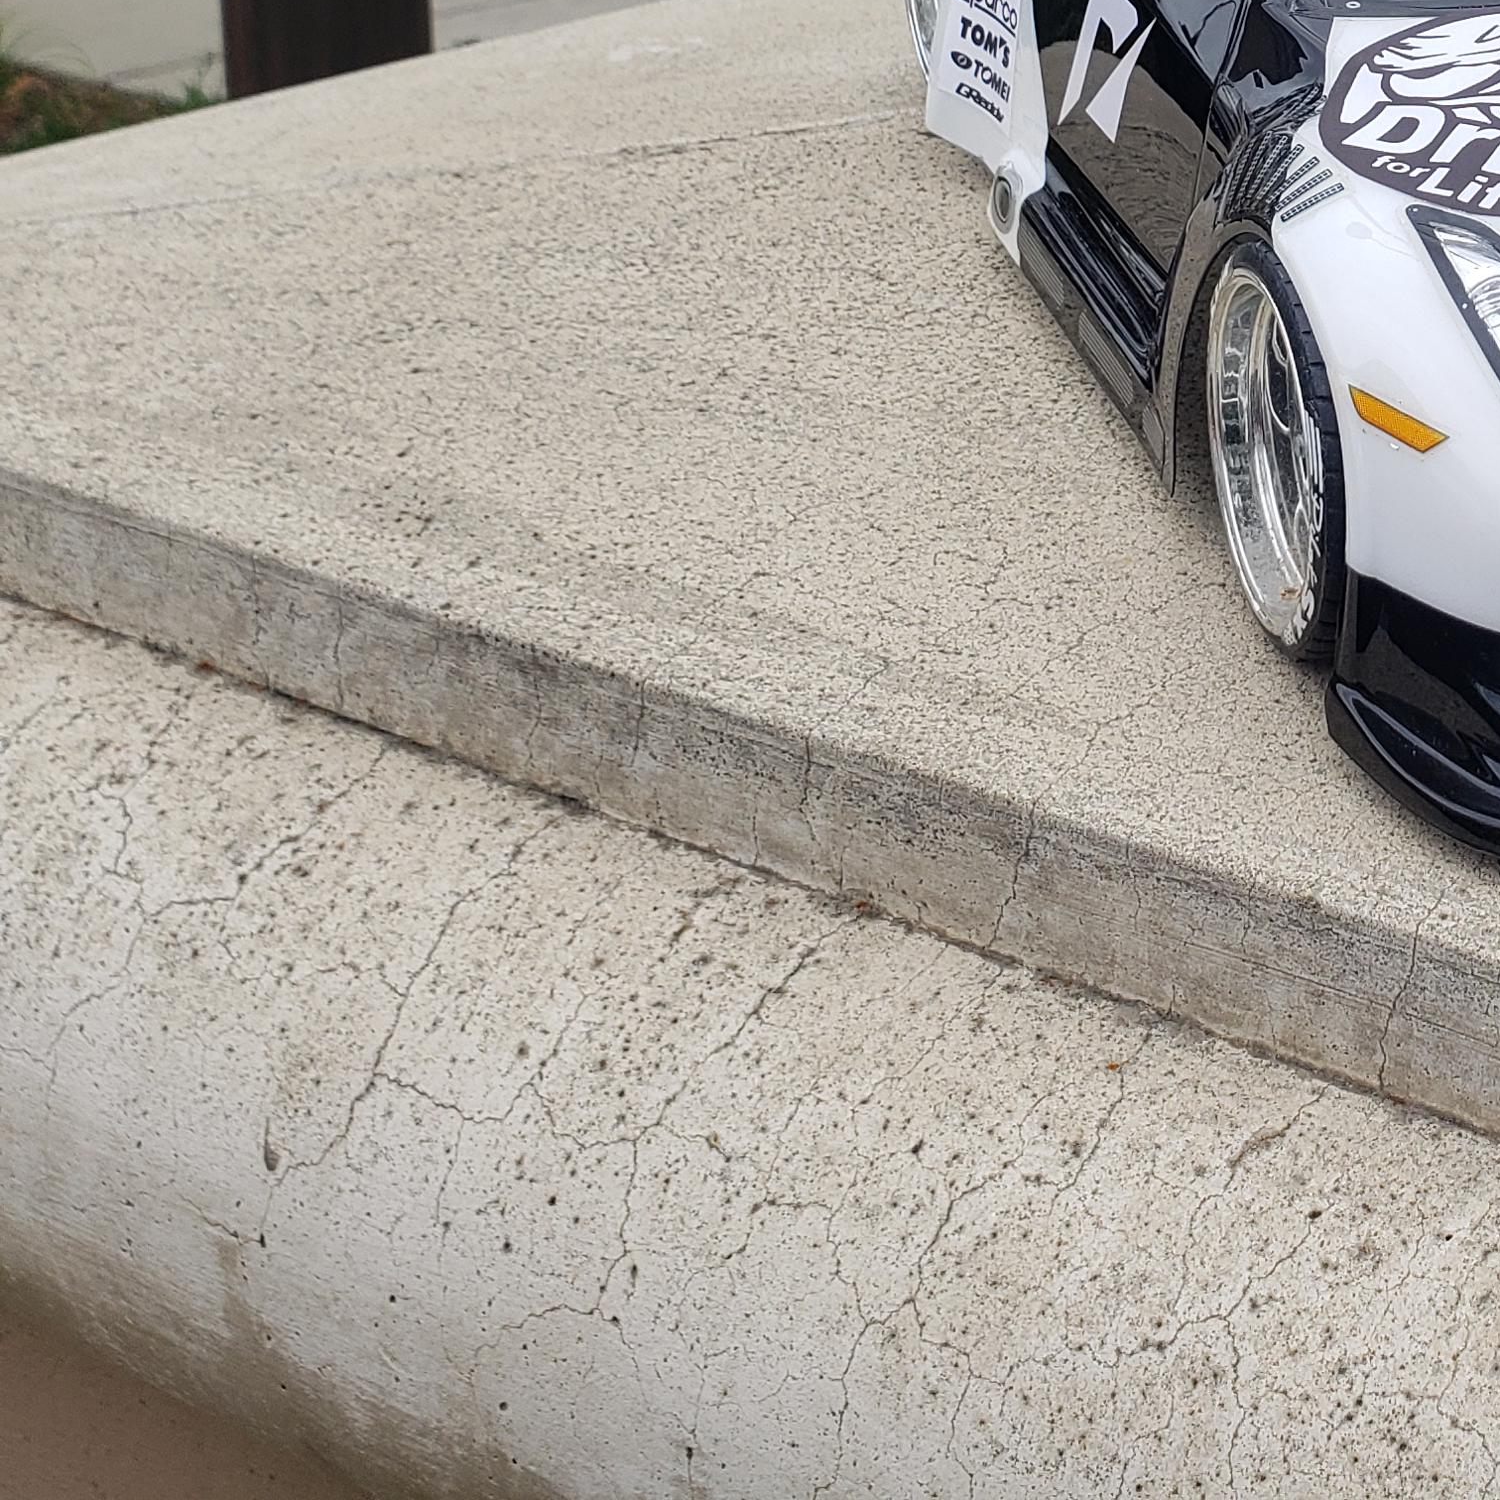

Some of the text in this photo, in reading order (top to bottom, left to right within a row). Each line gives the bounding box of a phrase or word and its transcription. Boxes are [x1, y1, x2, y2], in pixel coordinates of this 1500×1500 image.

[960, 16, 1010, 69] TOM'S
[974, 59, 1011, 103] TOMEI
[1371, 155, 1431, 178] for
